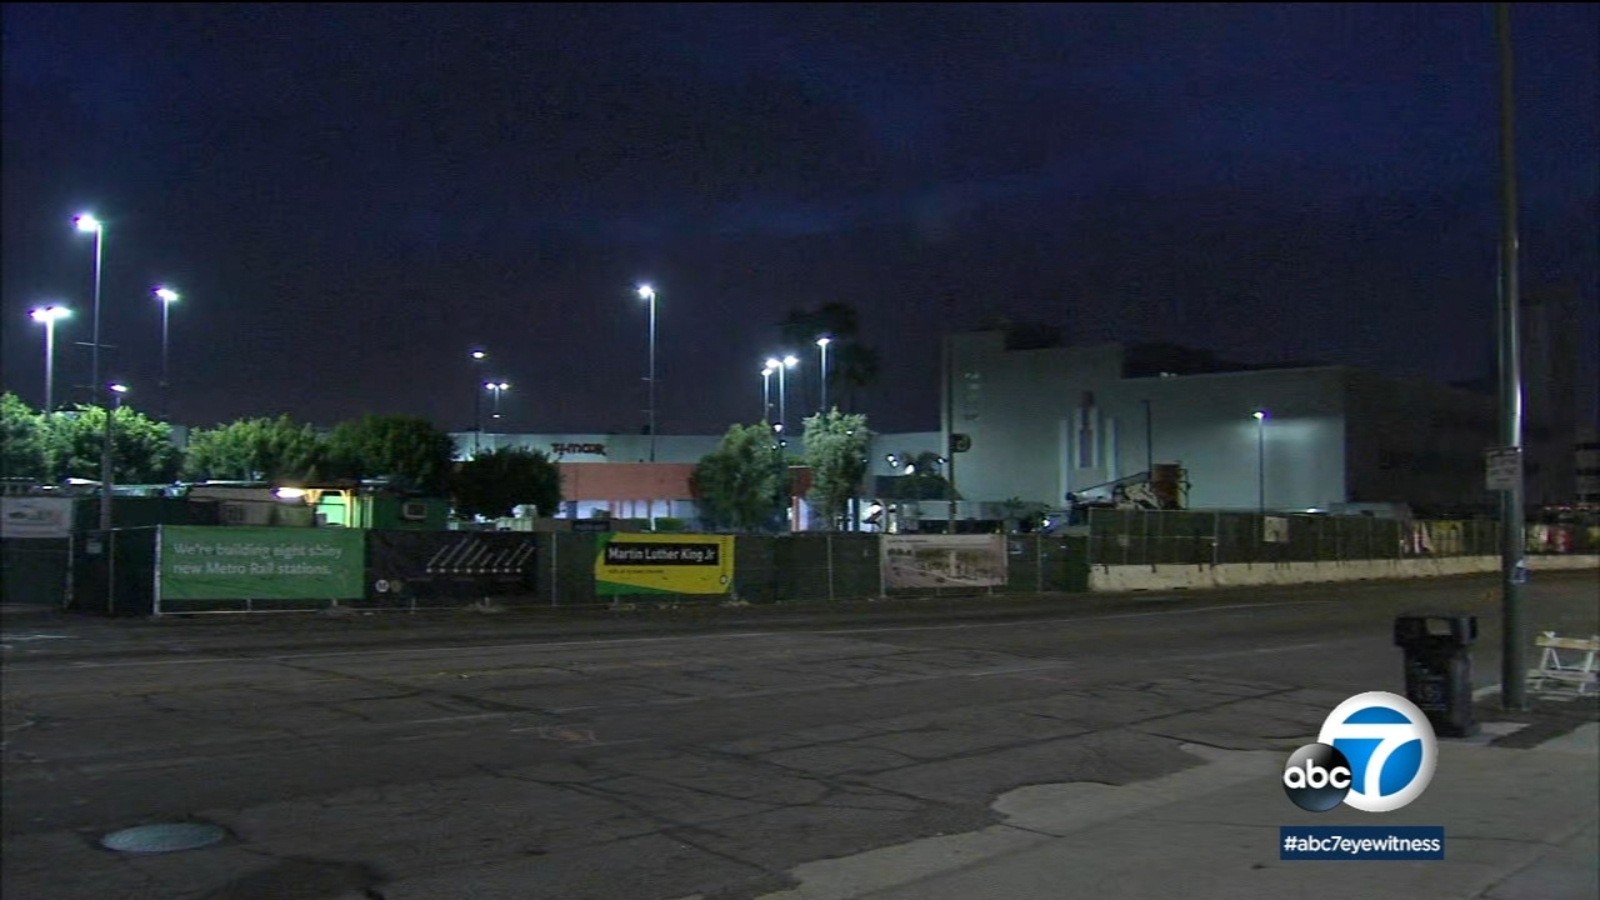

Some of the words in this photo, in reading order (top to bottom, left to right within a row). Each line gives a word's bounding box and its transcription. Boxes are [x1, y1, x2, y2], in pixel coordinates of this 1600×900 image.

[173, 543, 214, 556] We're
[216, 543, 270, 559] building
[272, 543, 306, 559] eight
[309, 544, 342, 559] shiny
[608, 547, 644, 560] Martin
[645, 548, 679, 560] Luther
[680, 549, 704, 562] King
[173, 563, 201, 574] new
[205, 562, 246, 574] Metro
[250, 562, 274, 574] Rail
